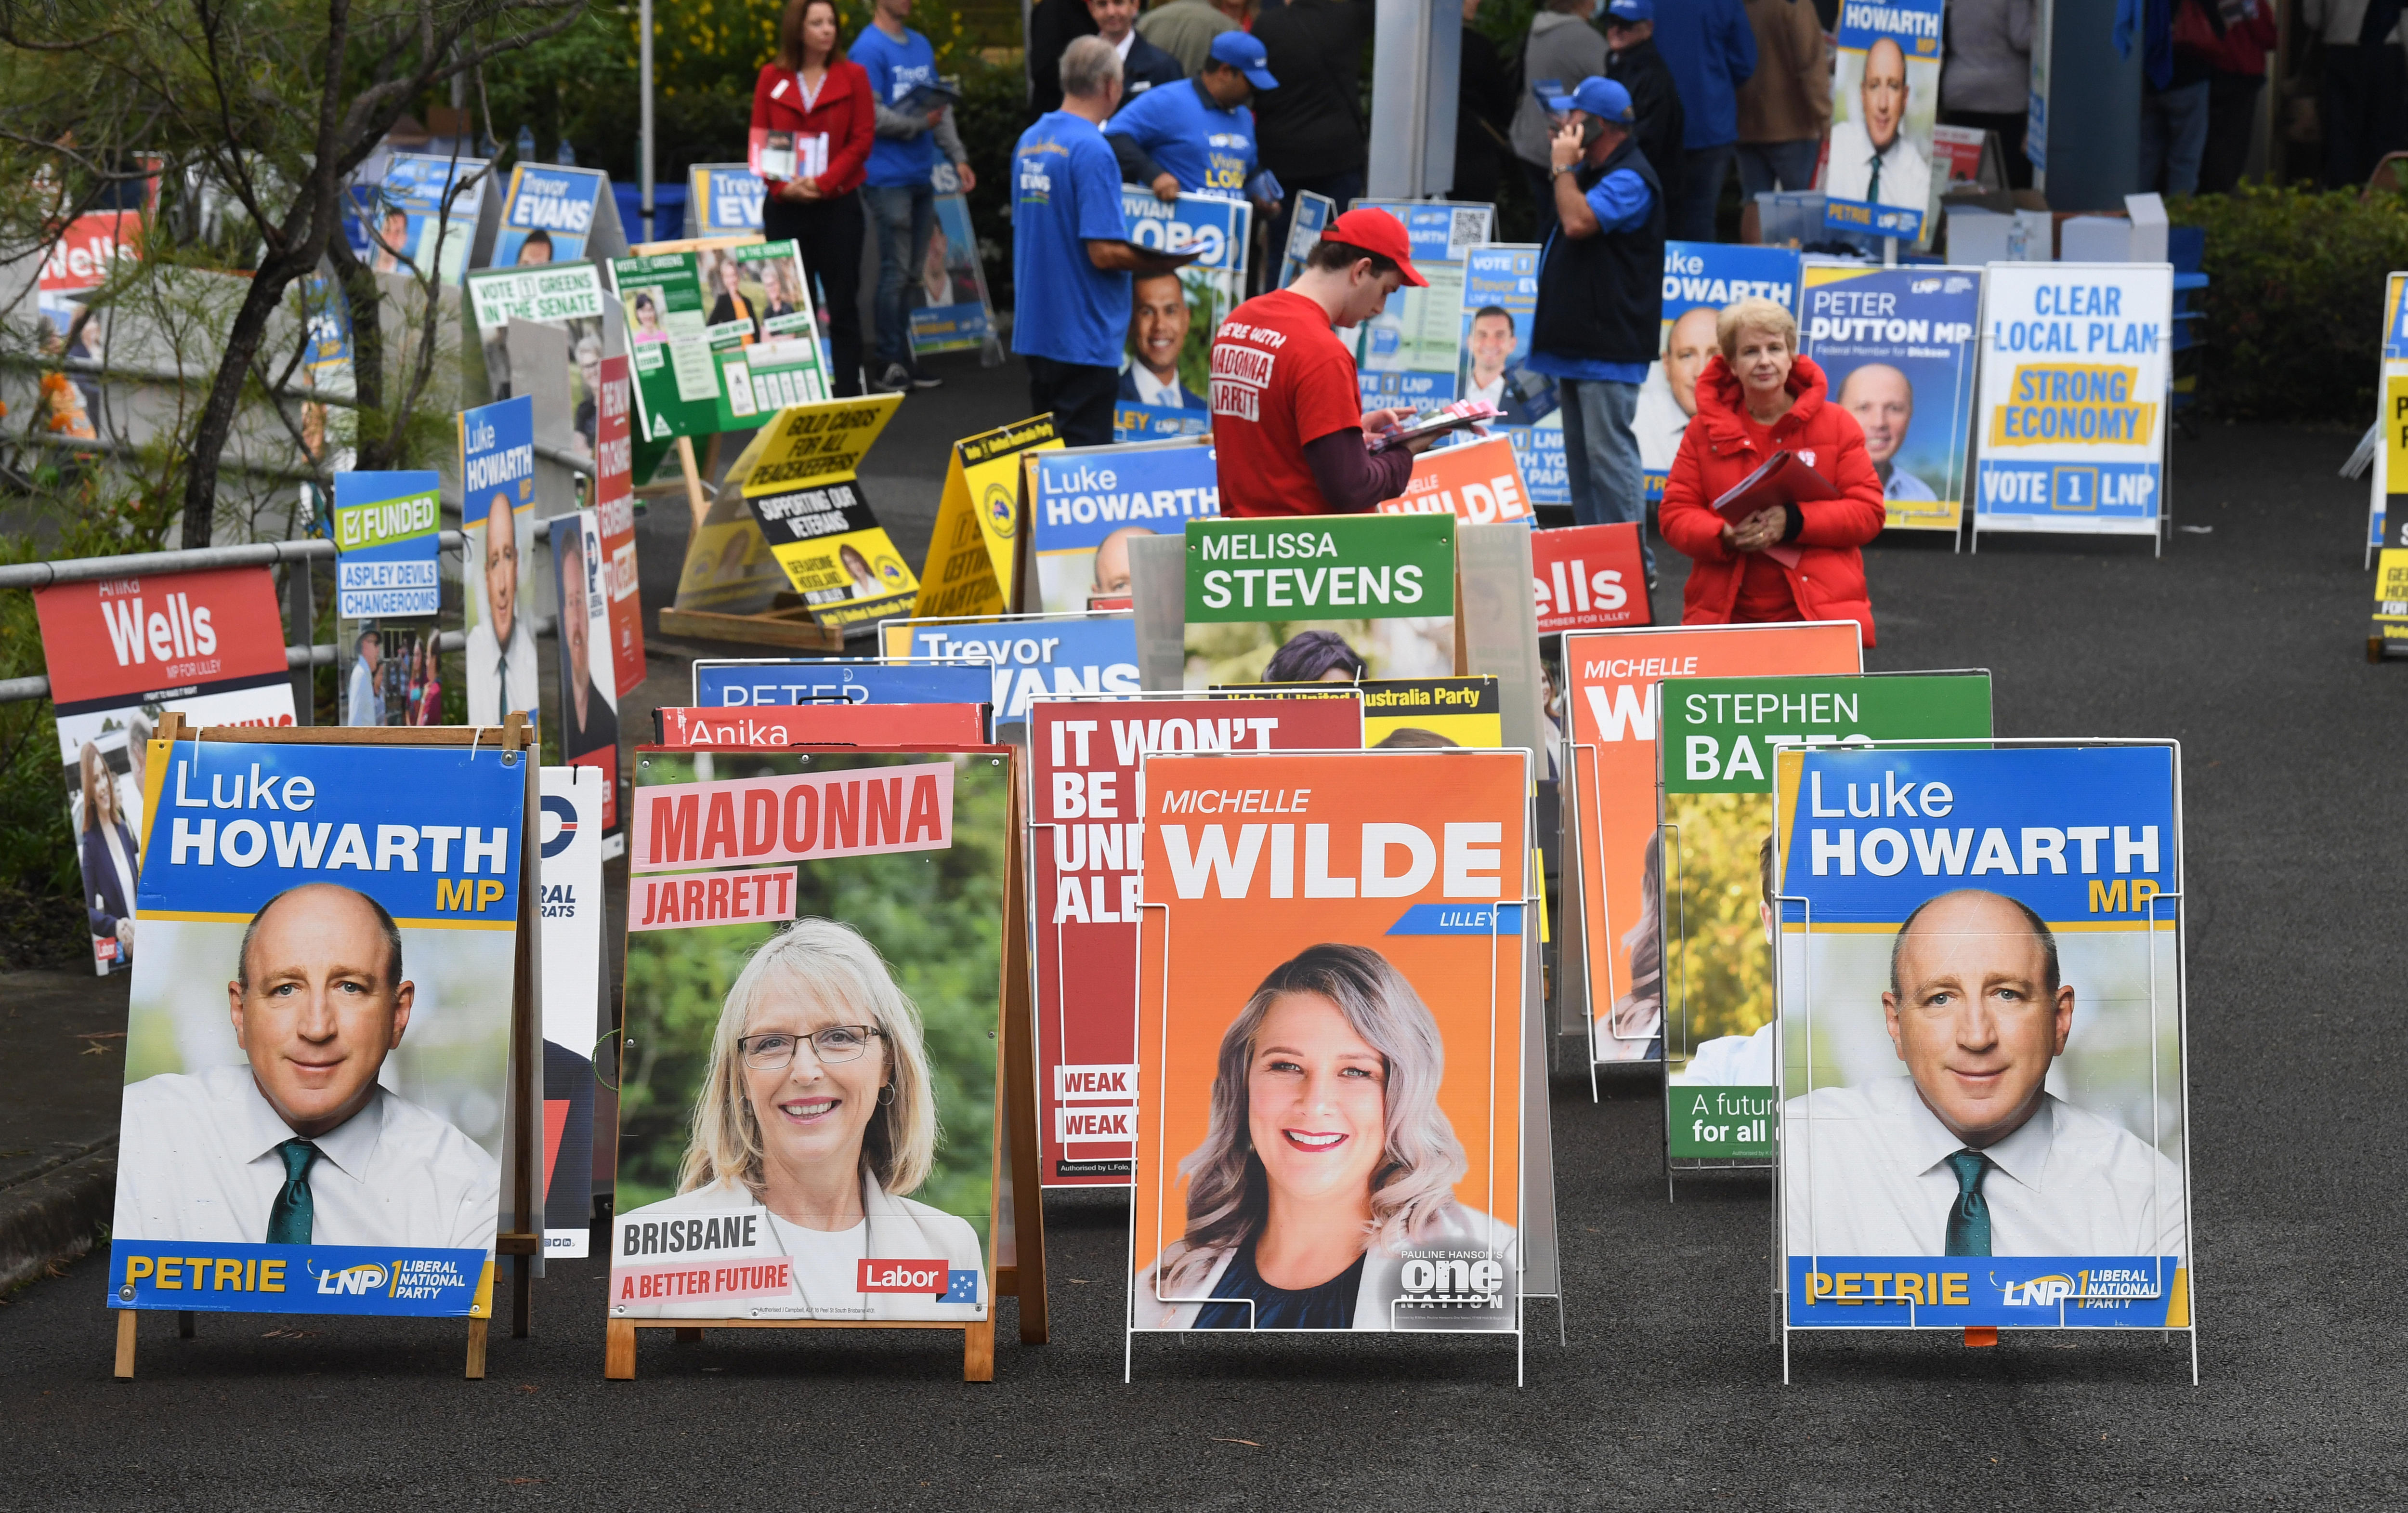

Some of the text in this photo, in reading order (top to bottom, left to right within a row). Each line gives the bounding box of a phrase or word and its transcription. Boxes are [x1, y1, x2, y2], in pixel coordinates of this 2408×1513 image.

[1845, 5, 1939, 37] HOWARTH
[1917, 39, 1937, 54] MP
[523, 172, 570, 196] Trevor
[513, 194, 590, 231] EVANS
[1123, 198, 1175, 220] IVIAN
[1829, 203, 1871, 225] PETRIE
[1132, 219, 1225, 264] OBO
[1473, 257, 1527, 270] VOTE 1
[480, 277, 514, 300] VOTE
[538, 272, 592, 295] GREENS
[1472, 277, 1516, 291] Trevor
[1662, 276, 1792, 306] OWARTH
[483, 293, 598, 327] IN THE SENATE
[1814, 291, 1897, 316] PETER
[2035, 285, 2121, 316] CLEAR
[1249, 327, 1287, 349] WITH
[1810, 316, 1973, 343] DUTTON MP
[1994, 321, 2159, 353] LOCAL PLAN
[1387, 377, 1433, 393] 1 LNP
[2018, 369, 2127, 403] STRONG
[1362, 394, 1405, 409] BOTH
[2005, 405, 2141, 439] ECONOMY
[465, 420, 495, 454] Luke
[787, 436, 822, 457] FOR
[1514, 433, 1524, 447] 1
[467, 445, 532, 493] HOWARTH
[1043, 465, 1117, 494] Luke
[758, 485, 858, 521] SUPPORTING OUR
[1983, 470, 2156, 507] VOTE 1 LNP
[364, 497, 434, 540] FUNDED
[1046, 486, 1220, 526] HOWARTH
[786, 510, 850, 539] VETERANS
[1202, 532, 1338, 561] MELISSA
[345, 563, 434, 587] ASPLEY DEVILS
[1202, 565, 1424, 608] STEVENS
[1533, 559, 1627, 617] ells
[345, 592, 435, 614] CHANGEROOMS
[101, 592, 217, 666] Wells
[1536, 611, 1630, 627] MEMBER FOR LILLEY
[919, 633, 1059, 665] Trevor
[166, 659, 221, 679] MP FOR LILLEY
[1584, 657, 1698, 680] MICHELLE
[1364, 687, 1480, 708] ustralia Party
[1685, 694, 1858, 724] STEPHEN
[690, 719, 788, 745] Anika
[1051, 718, 1278, 766] IT WON'T
[175, 761, 315, 811] Luke
[1052, 771, 1118, 818] BE
[1812, 771, 1953, 817] Luke
[1162, 789, 1311, 813] MICHELLE
[649, 775, 942, 864] MADONNA
[170, 818, 508, 874] HOWARTH
[1160, 822, 1502, 899] WILDE
[1812, 825, 2159, 877] HOWARTH
[436, 879, 505, 911] MP
[642, 872, 793, 925] JARRETT
[2089, 879, 2159, 912] MP
[1440, 912, 1500, 927] LILLEY
[1065, 1072, 1127, 1092] WEAK
[1692, 1094, 1709, 1115] A
[1066, 1115, 1128, 1135] WEAK
[1692, 1119, 1766, 1142] for all
[624, 1215, 757, 1256] BRISBANE
[126, 1256, 384, 1295] PETRIE LNP
[399, 1275, 465, 1287] NATIONAL
[402, 1260, 458, 1274] LIBERAL
[866, 1264, 939, 1288] Labor
[1401, 1260, 1503, 1293] one
[2090, 1270, 2148, 1282] LIBERAL
[396, 1286, 442, 1300] PARTY
[622, 1264, 788, 1300] A BETTER FUTURE
[1806, 1272, 2068, 1306] PETRIE LNP
[2088, 1283, 2158, 1295] NATIONAL
[1400, 1294, 1503, 1309] NATION
[2086, 1298, 2132, 1309] PARTY
